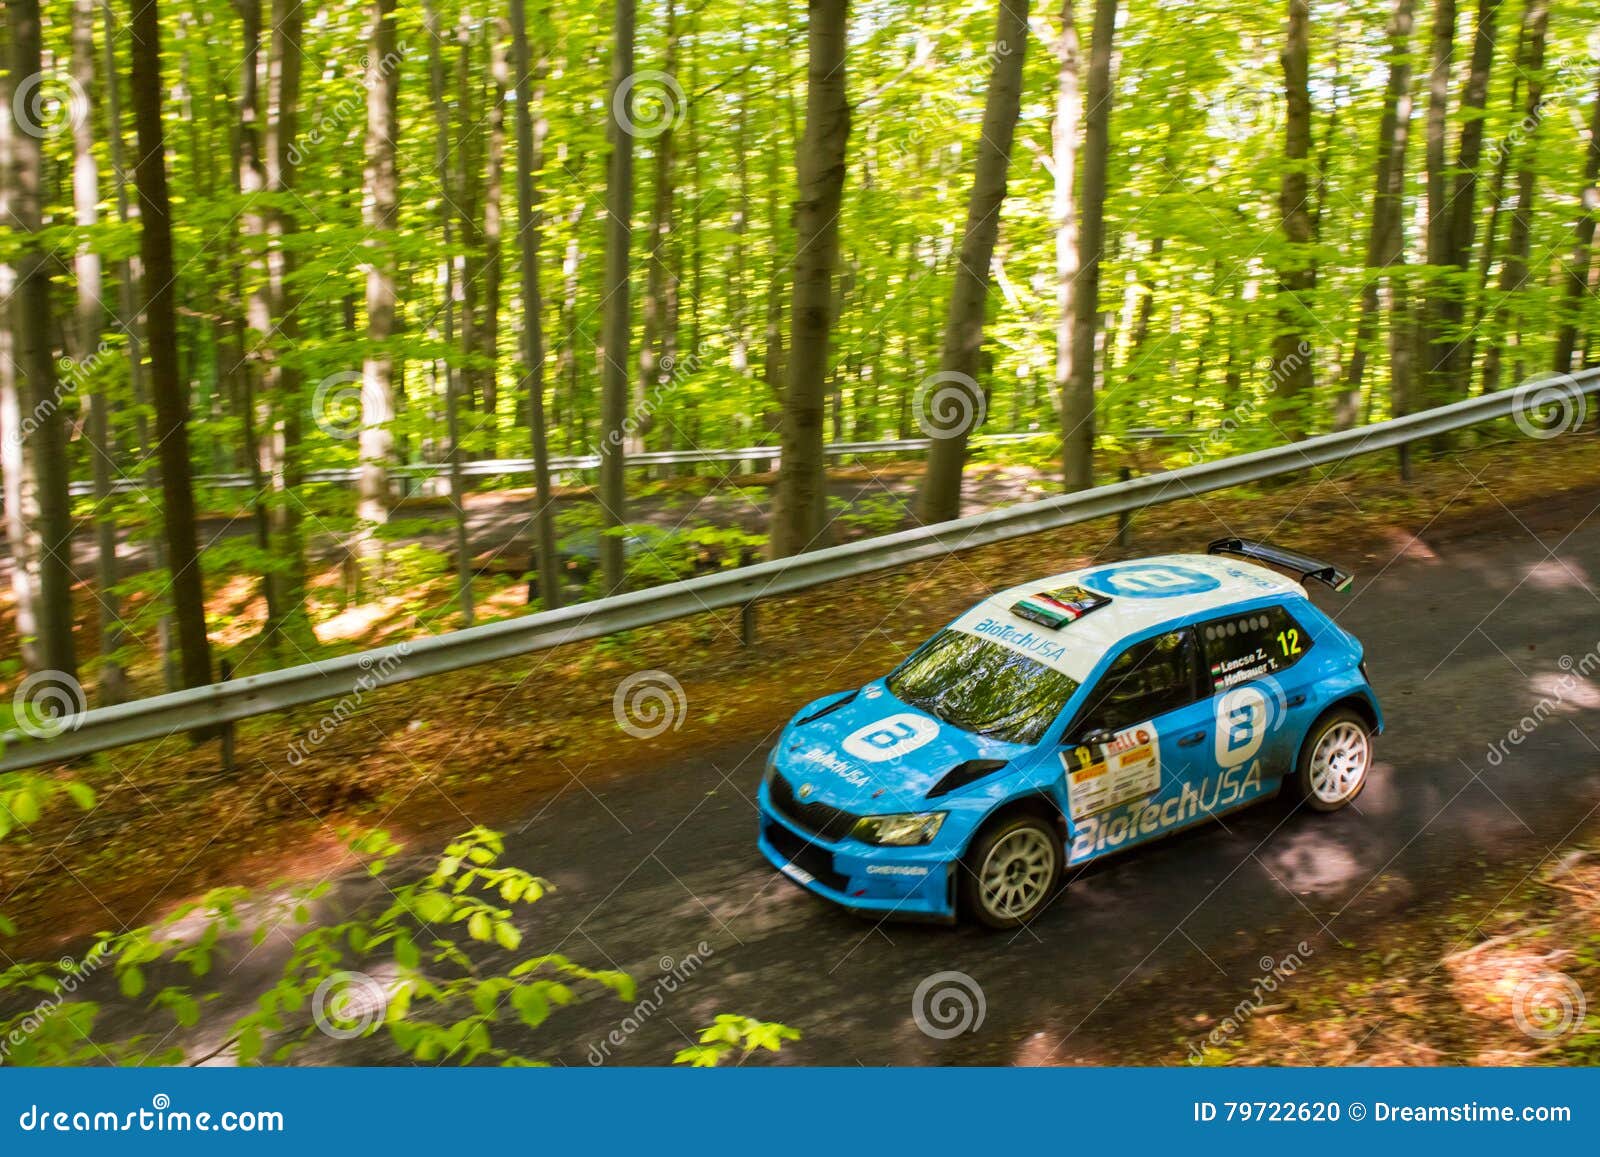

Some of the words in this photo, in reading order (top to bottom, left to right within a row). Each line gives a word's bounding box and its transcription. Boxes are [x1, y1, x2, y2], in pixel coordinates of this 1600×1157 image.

[974, 618, 1067, 662] BioTechUSA
[1277, 628, 1301, 656] 12
[1220, 652, 1255, 674] Lencse
[1255, 648, 1268, 661] Z.
[1223, 663, 1268, 688] Hofbauer
[1268, 658, 1279, 671] T.
[1069, 759, 1262, 860] BioTechUSA
